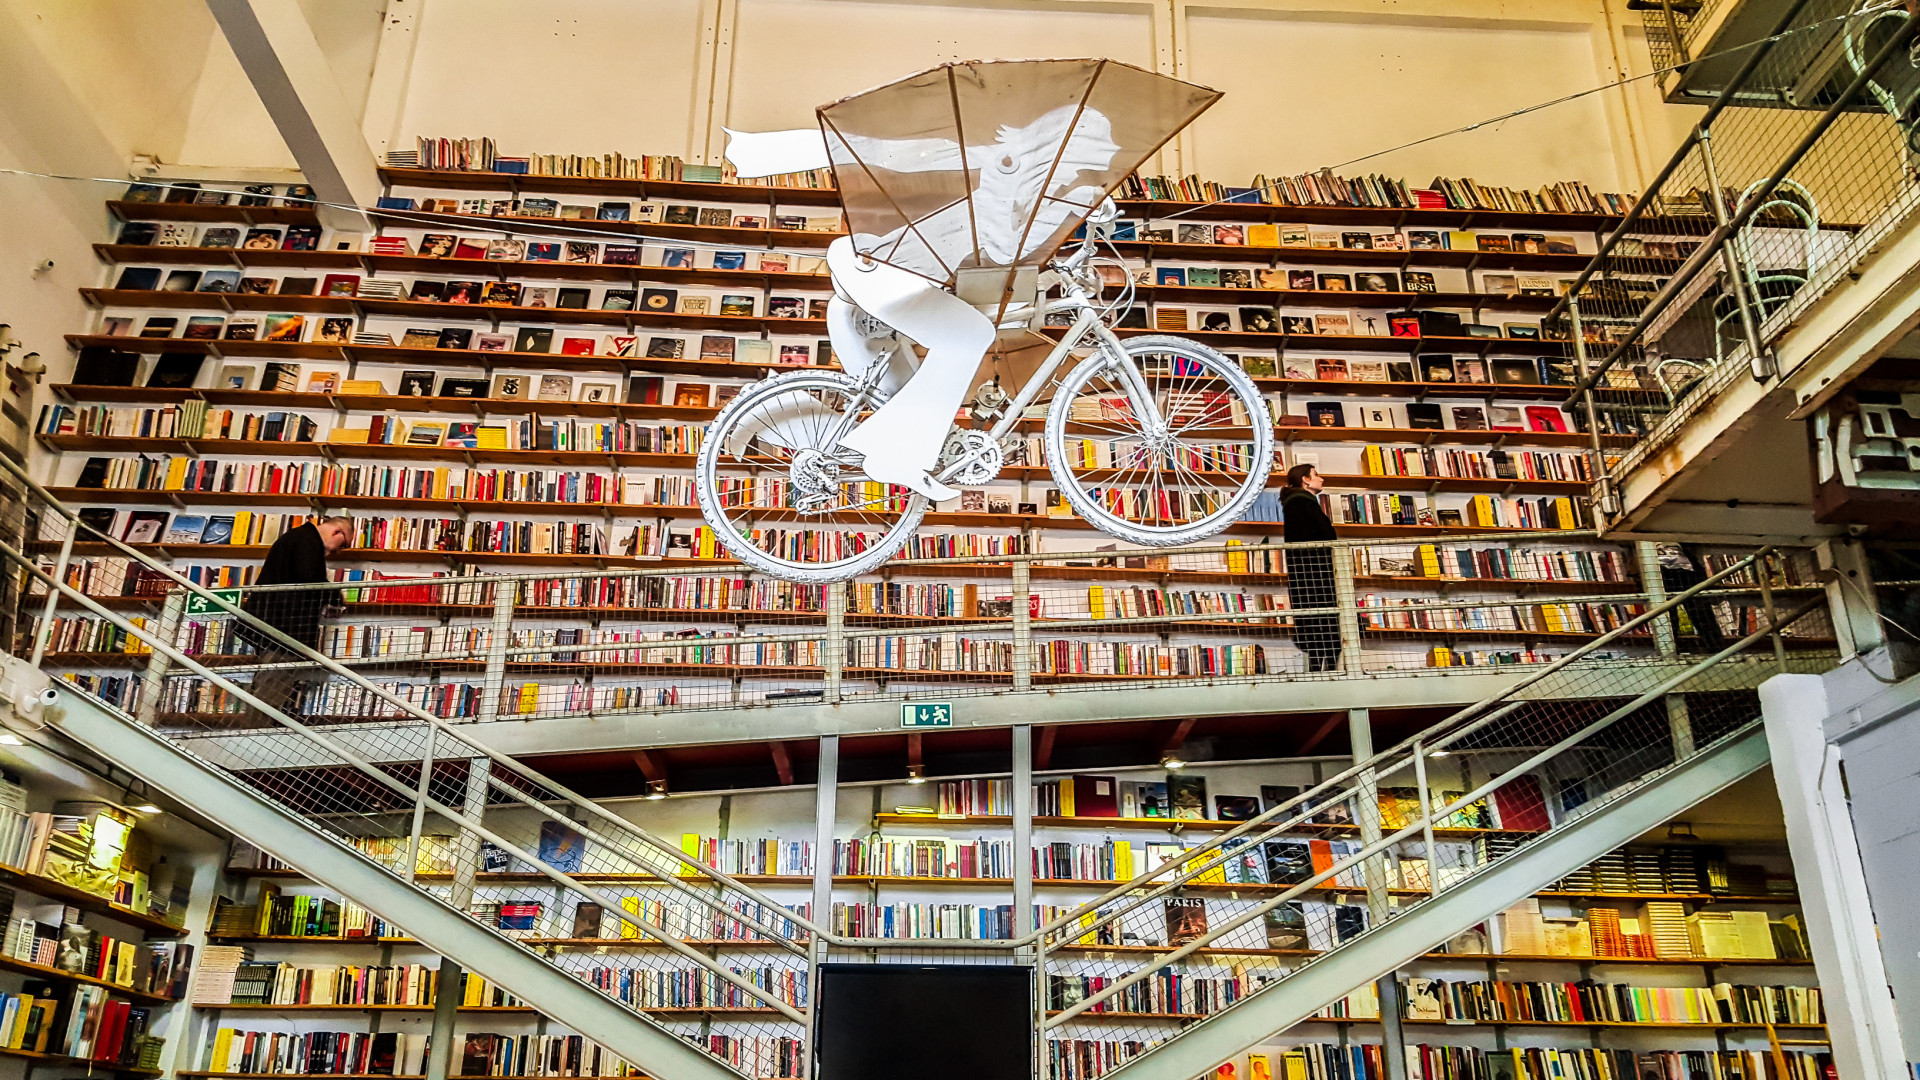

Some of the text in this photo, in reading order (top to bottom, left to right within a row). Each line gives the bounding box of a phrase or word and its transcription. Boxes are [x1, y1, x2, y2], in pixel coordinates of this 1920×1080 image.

[1406, 282, 1435, 291] BEST
[1317, 317, 1349, 325] DESIGN
[1166, 897, 1203, 908] PARIS
